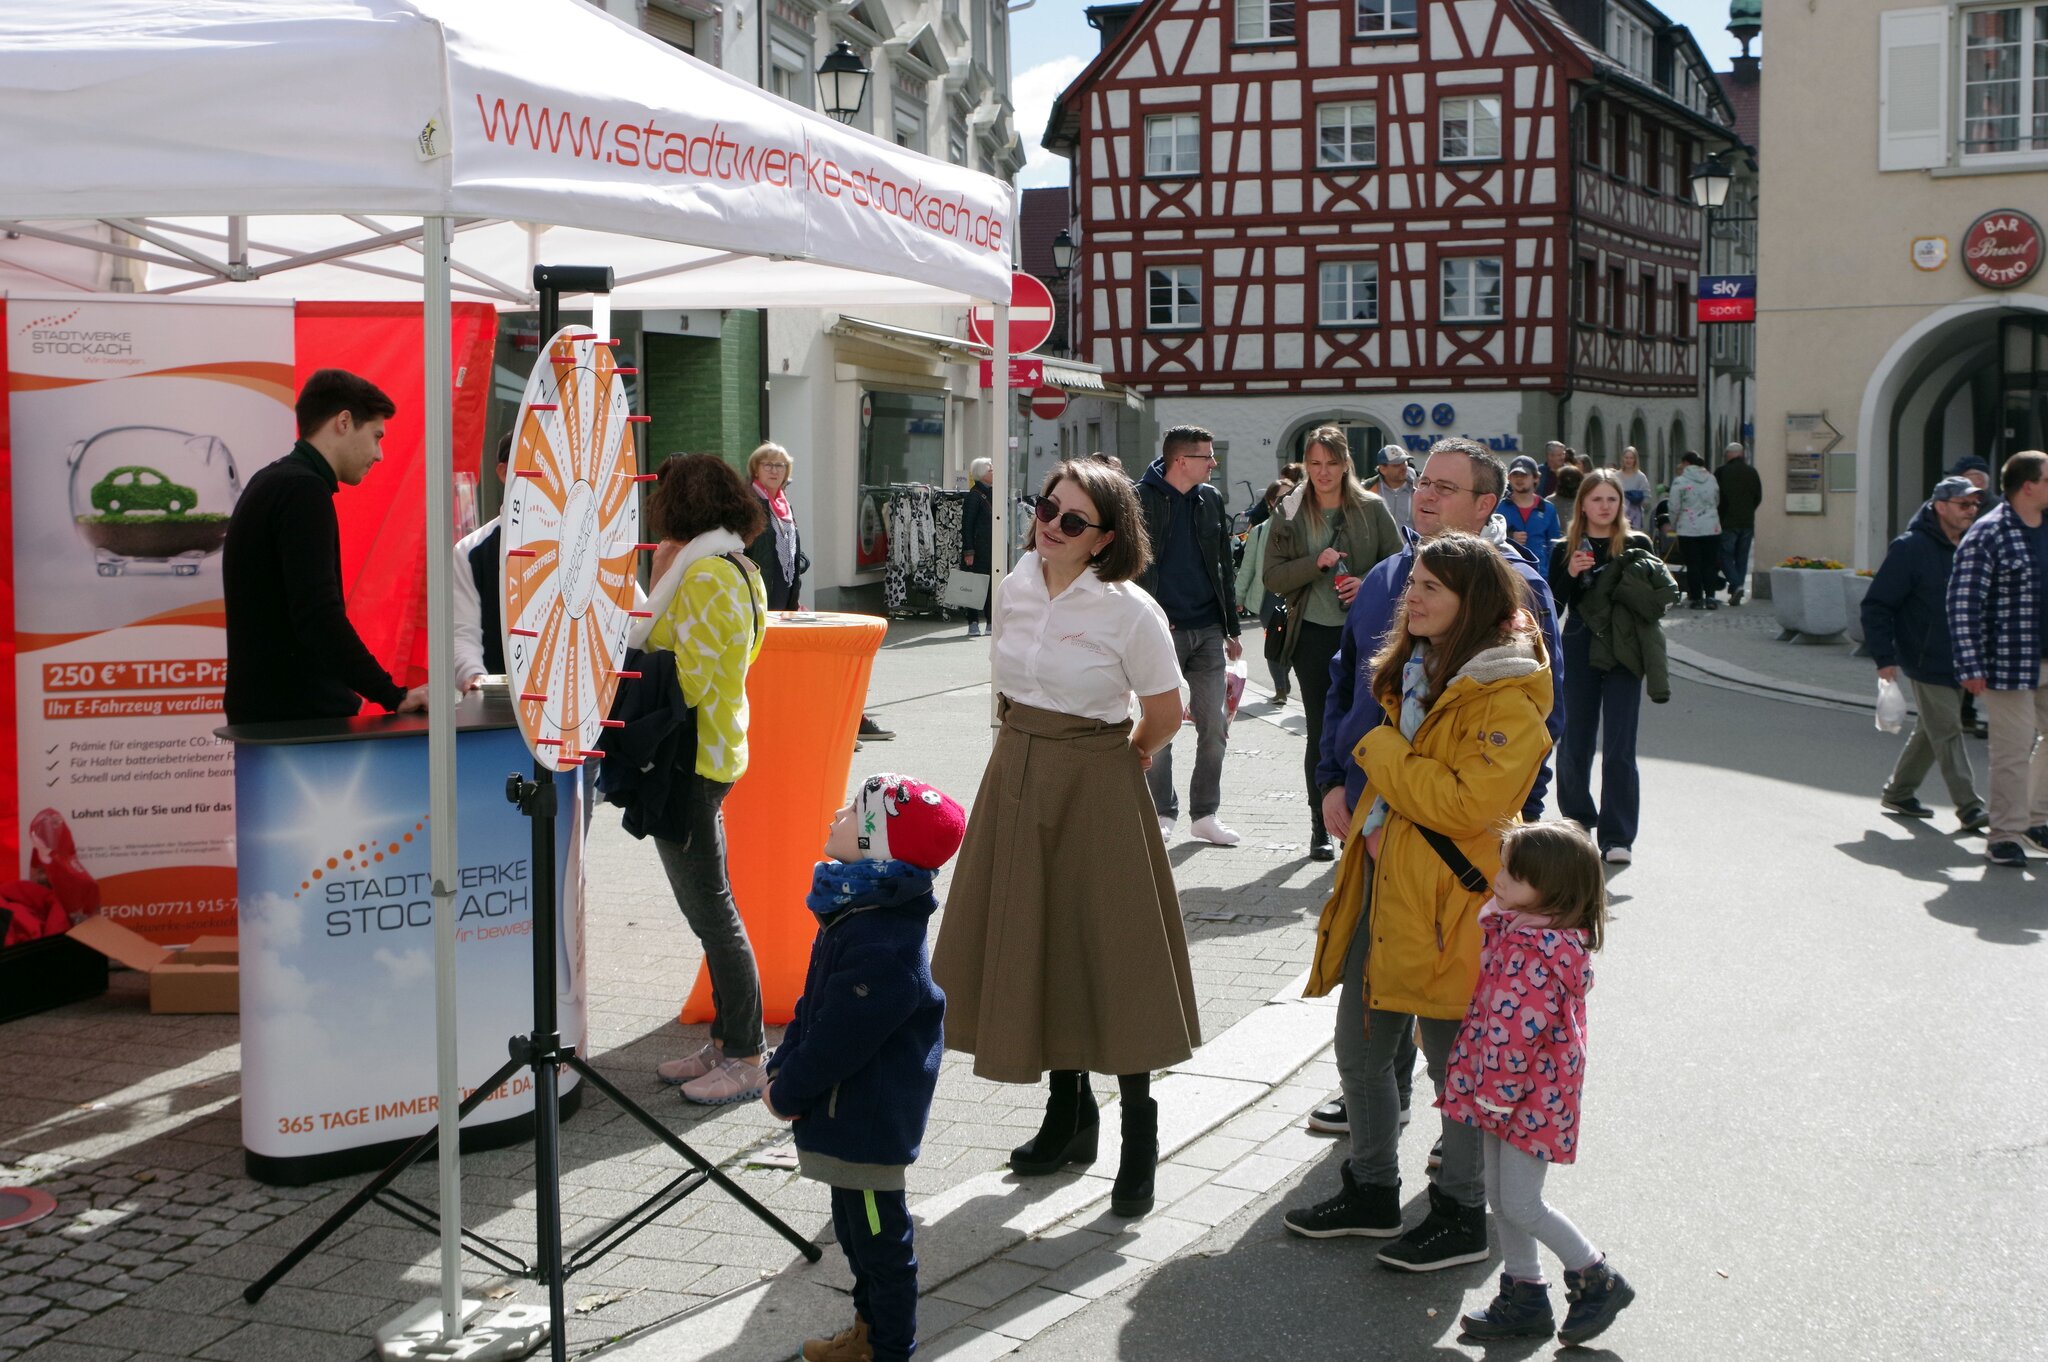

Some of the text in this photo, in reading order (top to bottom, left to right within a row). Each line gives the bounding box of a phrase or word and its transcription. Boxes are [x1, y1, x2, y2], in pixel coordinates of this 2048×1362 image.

[475, 93, 1002, 253] www.stadtwerke-stockach.de
[1983, 217, 2019, 234] BAR
[1967, 236, 2036, 259] Brasil
[1976, 261, 2028, 281] BISTRO
[1712, 280, 1742, 297] sky
[1709, 305, 1743, 317] sport
[31, 330, 132, 342] STADTWERKE
[31, 342, 132, 356] STOCKACH
[601, 353, 608, 372] 5
[539, 378, 547, 399] 2
[565, 379, 581, 473] NOCHMAL
[522, 436, 531, 450] 1
[1402, 433, 1519, 452] Volnk
[534, 448, 560, 495] GEWINN
[605, 466, 626, 517] GEWINN
[512, 499, 521, 526] 18
[522, 549, 557, 583] TROSTPREIS
[509, 576, 519, 605] 17
[536, 605, 561, 688] NOCHMAL
[618, 631, 626, 655] 10
[514, 643, 523, 674] 16
[49, 665, 96, 687] 250
[567, 646, 575, 723] GEWINN
[47, 701, 71, 716] Ihr
[74, 698, 162, 715] E-Fahrzeug
[526, 699, 537, 726] 15
[586, 719, 595, 744] 12
[70, 741, 107, 752] Prämie
[109, 739, 124, 752] für
[126, 737, 187, 751] eingesparte
[70, 758, 88, 768] Für
[90, 755, 123, 767] Halter
[125, 752, 224, 766] batteriebetriebener
[70, 773, 109, 785] Schnell
[110, 771, 131, 782] und
[133, 769, 172, 782] einfach
[174, 768, 206, 780] online
[71, 802, 232, 820] Lohnt sich für Sie und für das
[147, 901, 193, 917] 07771
[196, 898, 238, 914] 915-7
[326, 886, 528, 937] STOCACH
[278, 1114, 315, 1135] 365
[319, 1106, 371, 1130] TAGE
[374, 1097, 439, 1122] IMMER
[512, 1075, 534, 1096] DA.
